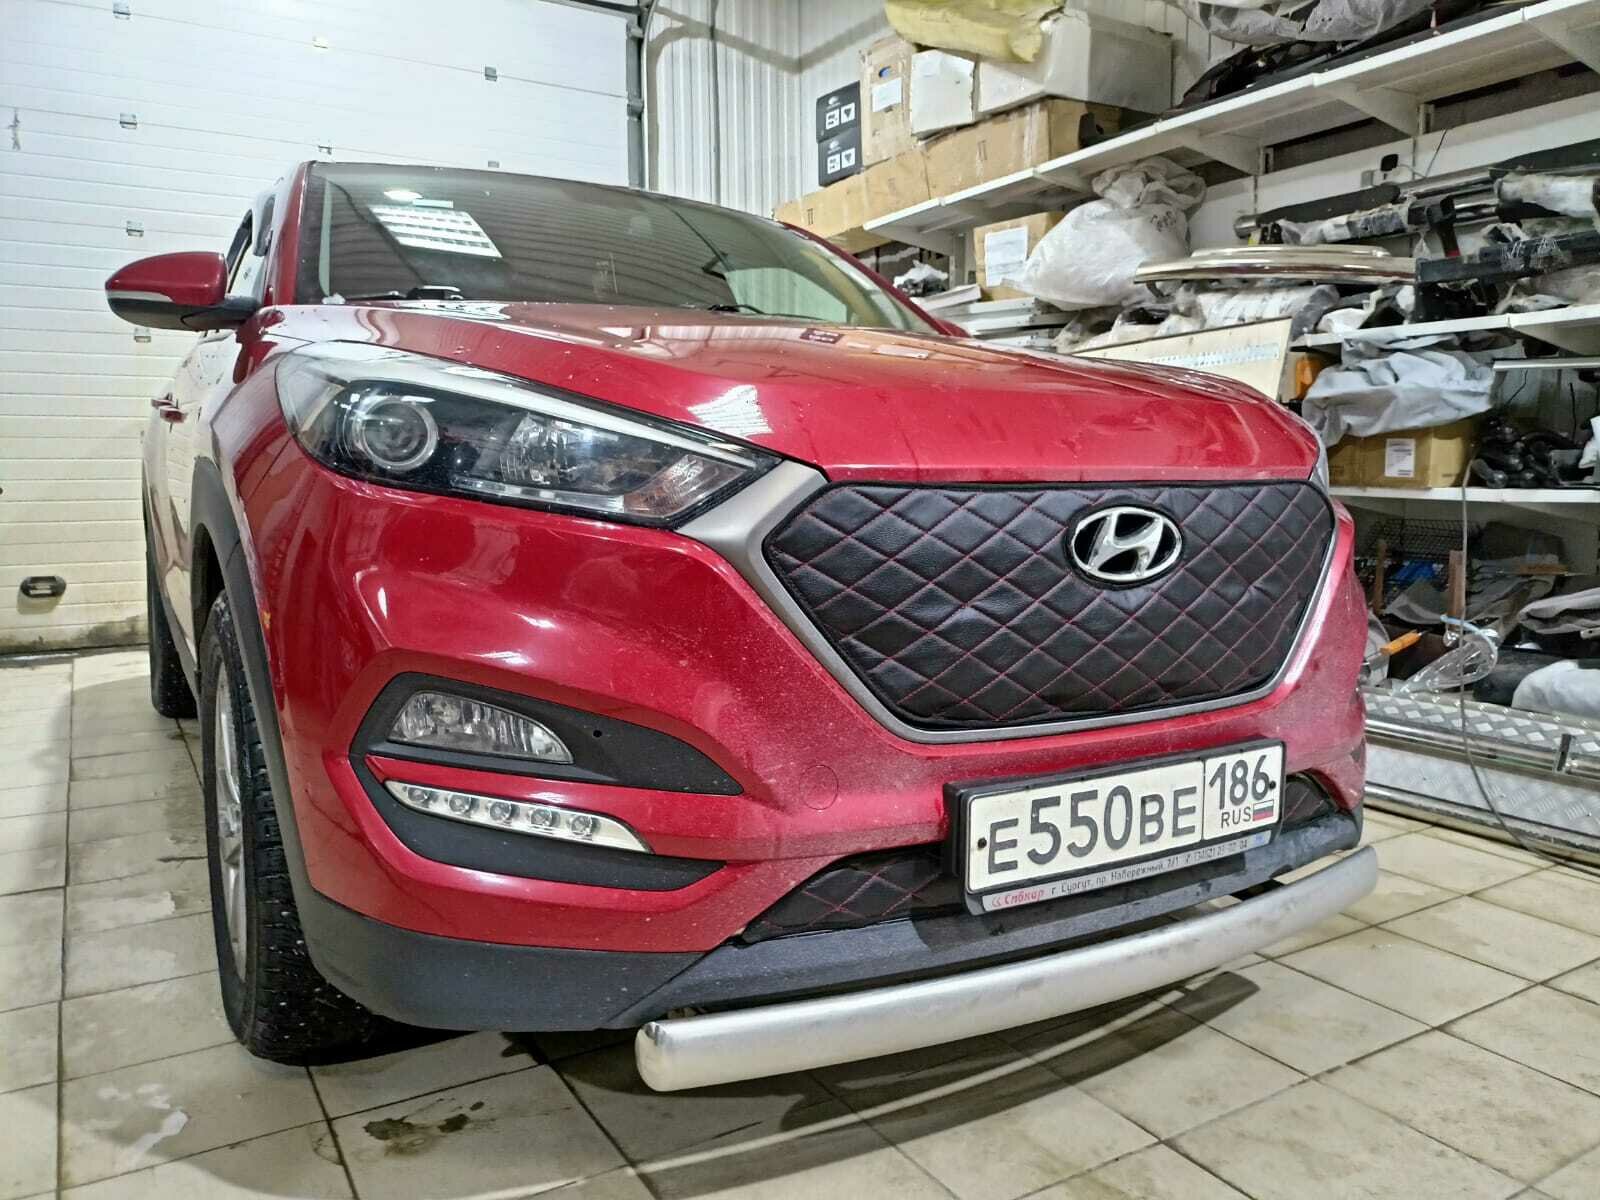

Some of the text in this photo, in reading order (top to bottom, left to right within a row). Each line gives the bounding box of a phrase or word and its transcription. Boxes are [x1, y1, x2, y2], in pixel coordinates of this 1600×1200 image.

[988, 755, 1270, 874] Е550ВЕ 186
[1221, 806, 1251, 829] RUS
